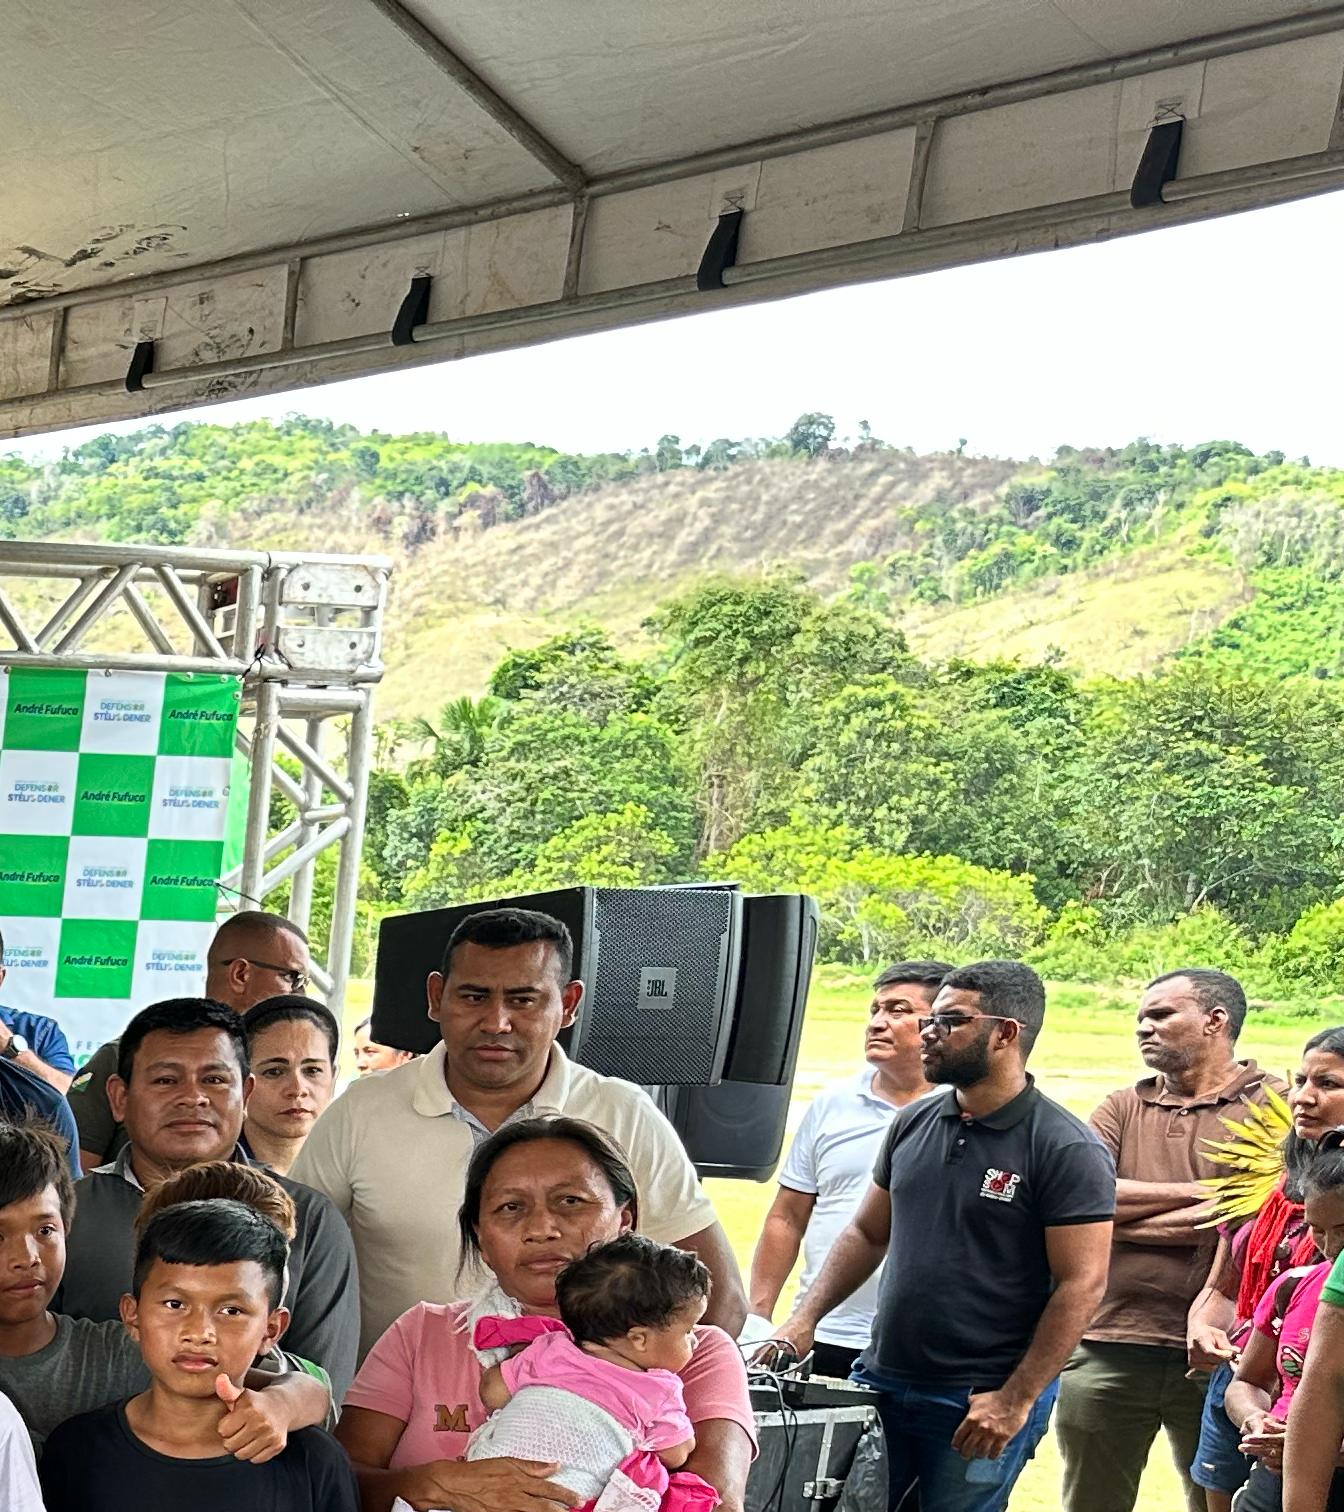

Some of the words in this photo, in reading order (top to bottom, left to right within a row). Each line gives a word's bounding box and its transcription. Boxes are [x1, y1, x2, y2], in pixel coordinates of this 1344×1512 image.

[14, 703, 44, 715] André
[44, 705, 79, 717] Fufuca
[169, 709, 198, 721] André
[199, 710, 233, 722] Fufuca
[93, 956, 128, 967] Fufuca
[647, 979, 667, 997] JBL
[434, 1403, 471, 1433] M
